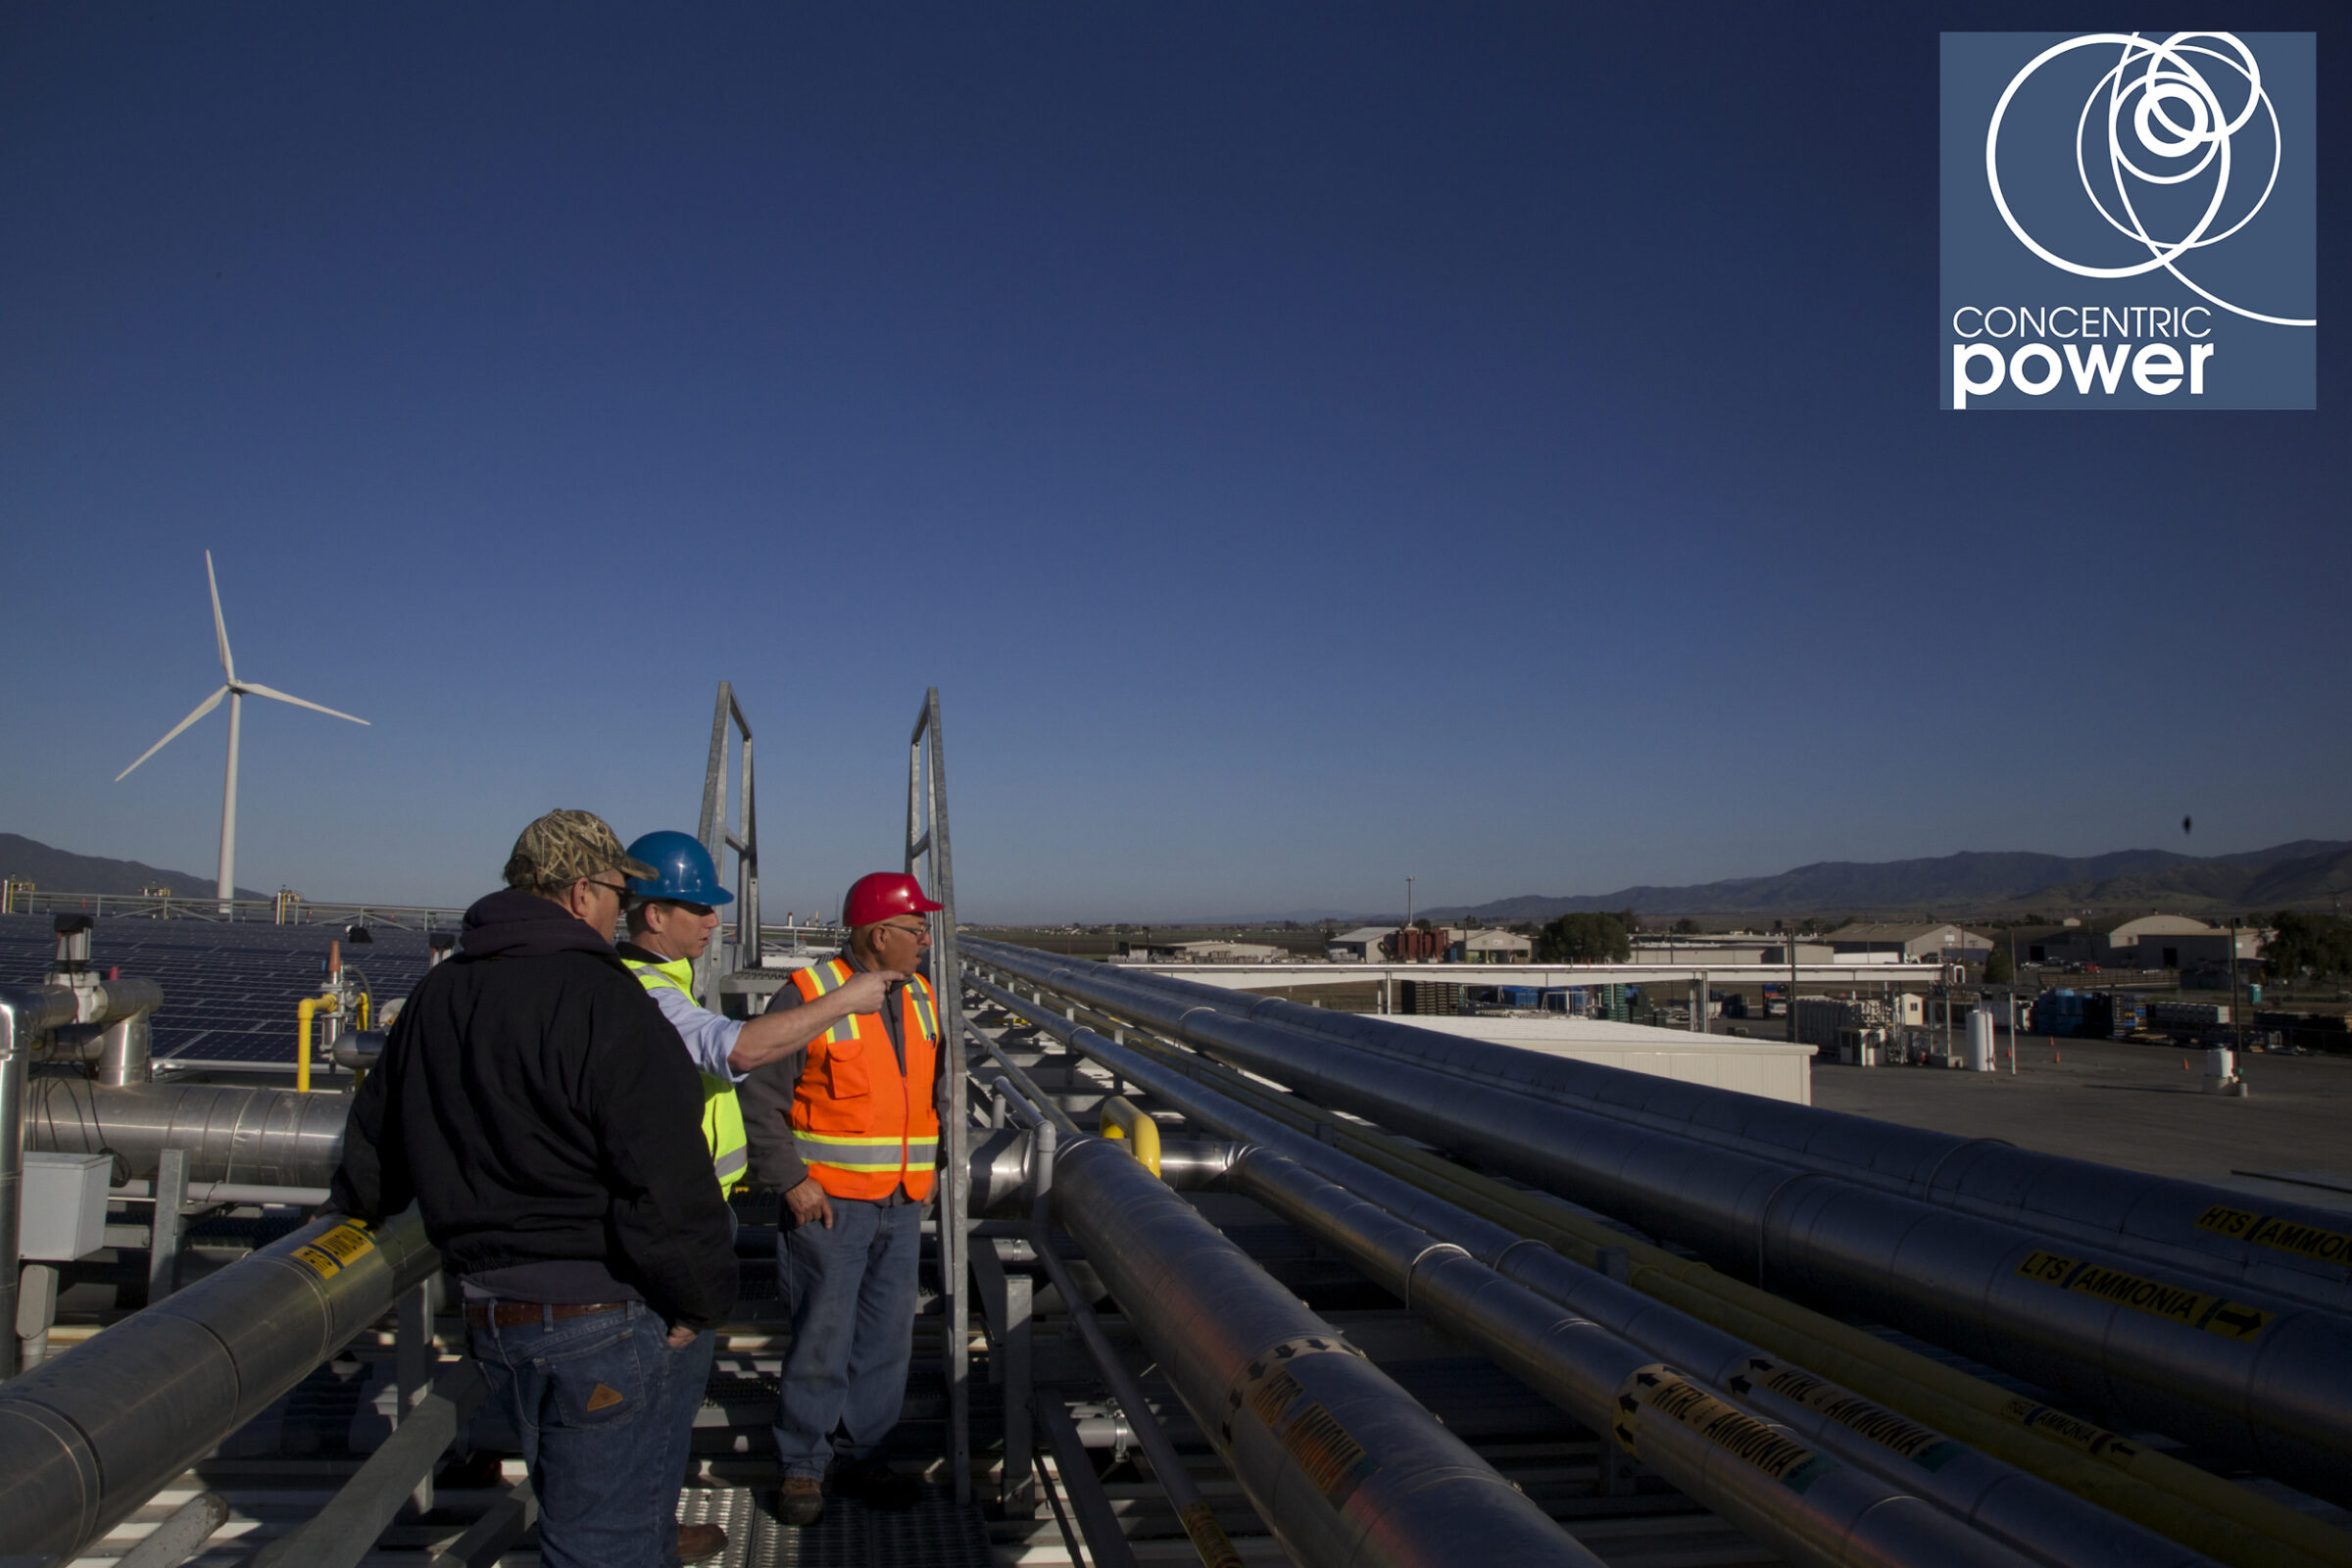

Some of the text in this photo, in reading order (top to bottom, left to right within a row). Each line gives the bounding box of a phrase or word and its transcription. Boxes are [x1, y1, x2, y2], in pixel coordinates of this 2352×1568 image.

[2200, 1207, 2250, 1233] HTS
[2020, 1252, 2199, 1319] LTS AMMONIA
[1652, 1382, 1710, 1420] HTRL
[1702, 1412, 1808, 1477] AMMONIA
[1824, 1398, 1939, 1456] AMMONIA
